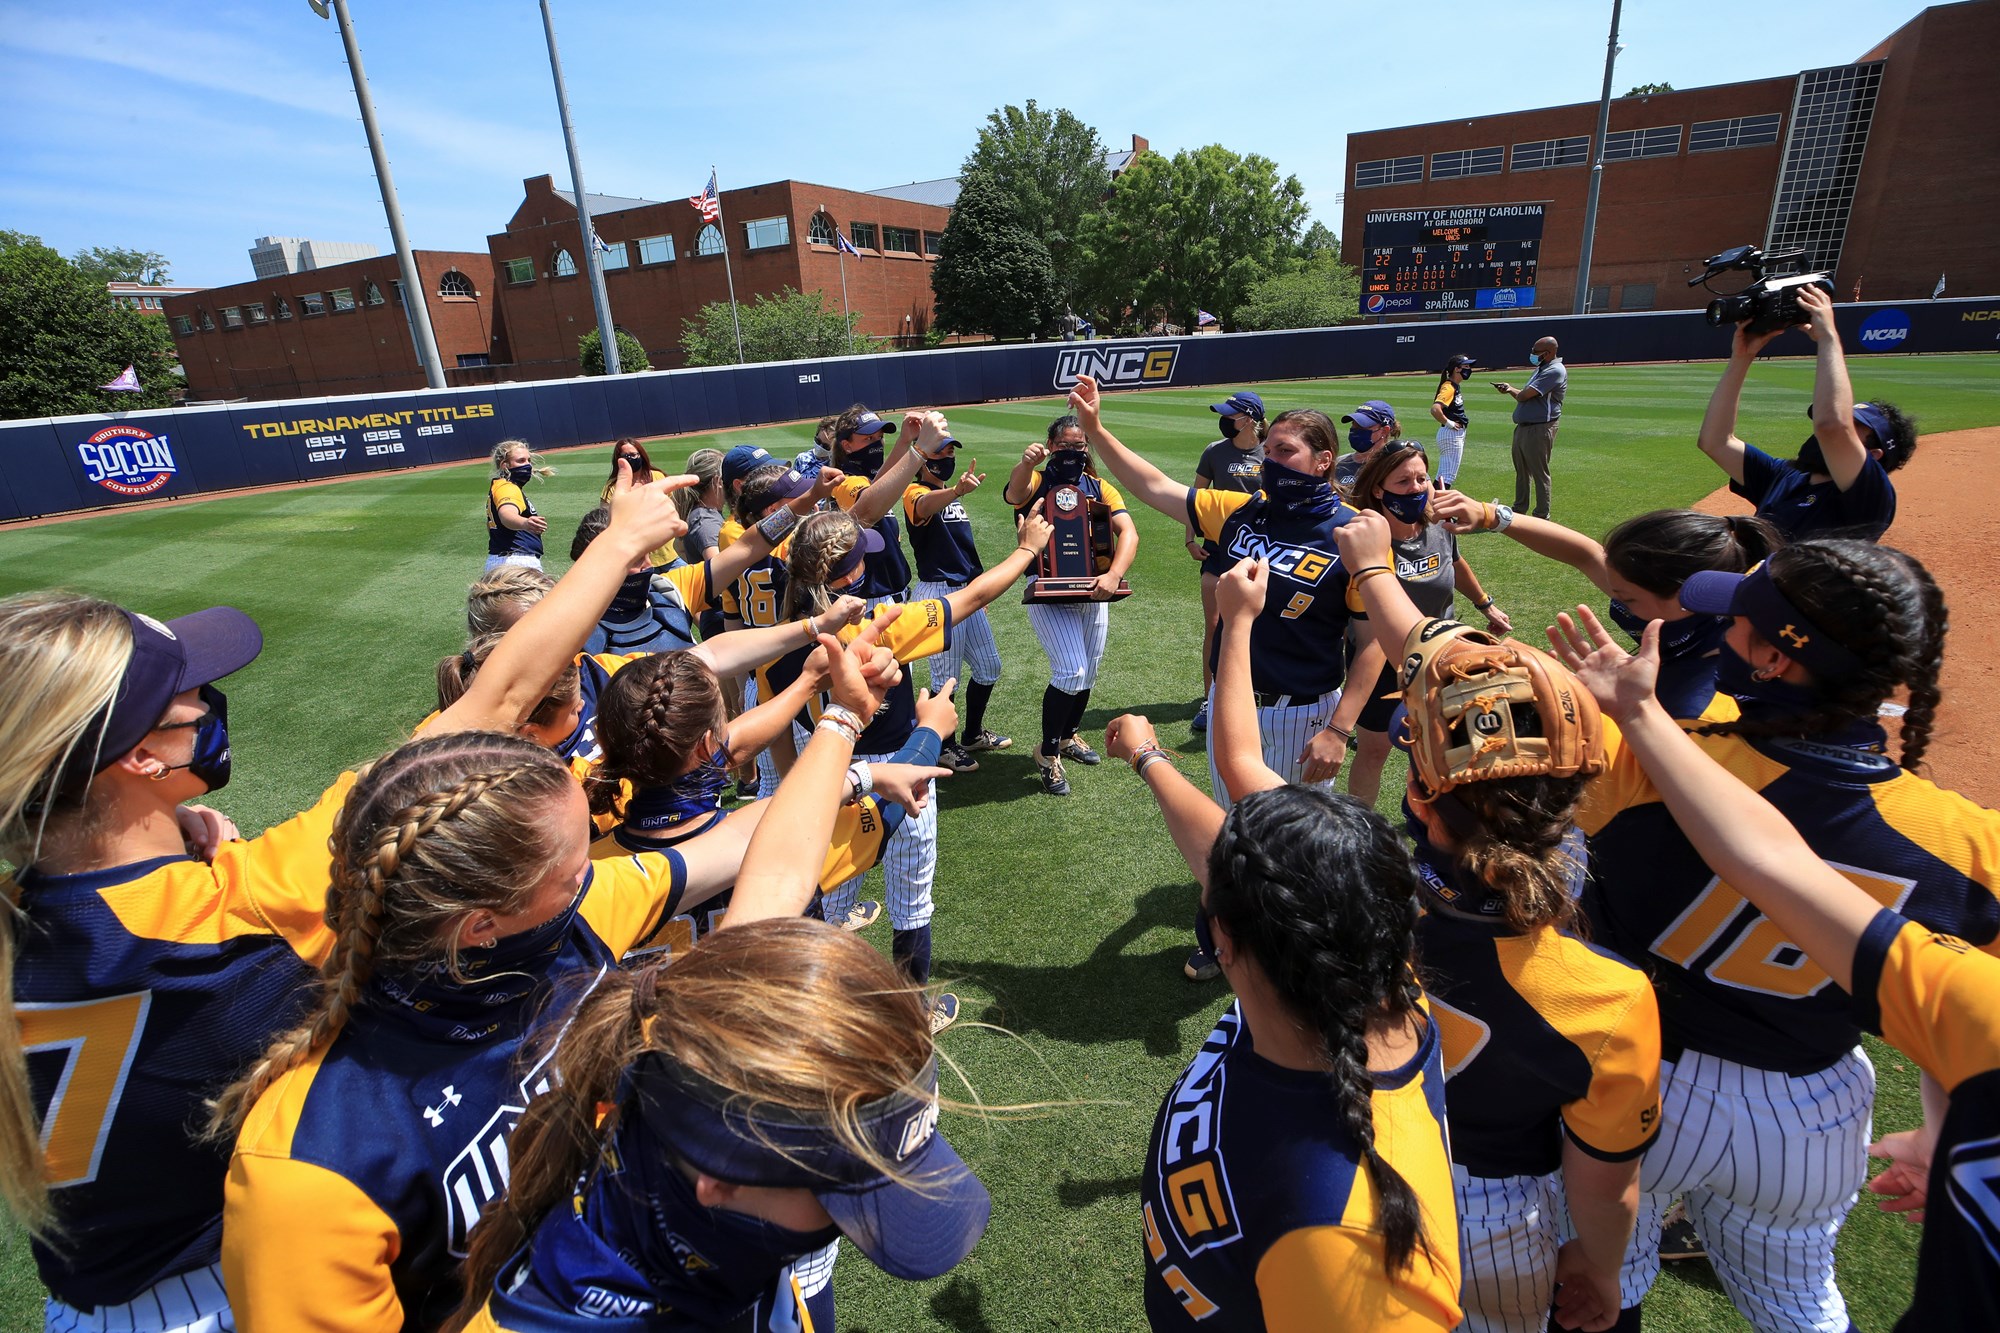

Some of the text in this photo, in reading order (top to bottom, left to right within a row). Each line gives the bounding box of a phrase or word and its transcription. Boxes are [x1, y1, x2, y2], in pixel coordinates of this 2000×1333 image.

[1367, 206, 1542, 223] UNIVERSITY OF NORTH CAROLINA
[1435, 218, 1483, 226] GREENSBORO
[1448, 244, 1469, 252] STRIKE
[1486, 250, 1492, 260] 0
[1376, 255, 1390, 266] 22
[1416, 254, 1422, 264] 0
[1454, 252, 1460, 262] 0
[1397, 272, 1401, 280] 0
[1405, 272, 1410, 280] 0
[1424, 271, 1428, 279] 0
[1432, 271, 1436, 279] 0
[1439, 270, 1444, 278] 0
[1451, 270, 1456, 278] 0
[1497, 268, 1502, 276] 0
[1516, 267, 1521, 275] 2
[1396, 283, 1401, 291] 0
[1431, 281, 1436, 289] 0
[1496, 278, 1501, 286] 5
[1527, 277, 1532, 285] 0
[1385, 297, 1411, 307] pepsi
[1442, 292, 1454, 300] GO
[1425, 300, 1469, 309] SPARTANS
[1397, 335, 1415, 343] 210
[1862, 328, 1907, 340] NCAA
[1059, 351, 1173, 383] UNCG
[799, 374, 820, 383] 210
[243, 404, 494, 439] TOURNAMENT TITLES
[95, 428, 146, 442] SOUTHERN
[305, 424, 454, 448] 1994 1995 1996
[308, 443, 405, 462] 1997 2018
[1228, 463, 1261, 473] UNCG
[106, 475, 167, 493] CONFERENCE
[1228, 524, 1340, 587] UNCG
[1398, 552, 1441, 578] UNCG
[738, 568, 779, 627] 16
[1280, 591, 1314, 619] 9
[1558, 689, 1576, 725] A2K
[1786, 742, 1880, 766] ARMOUR
[641, 812, 681, 829] UNCG
